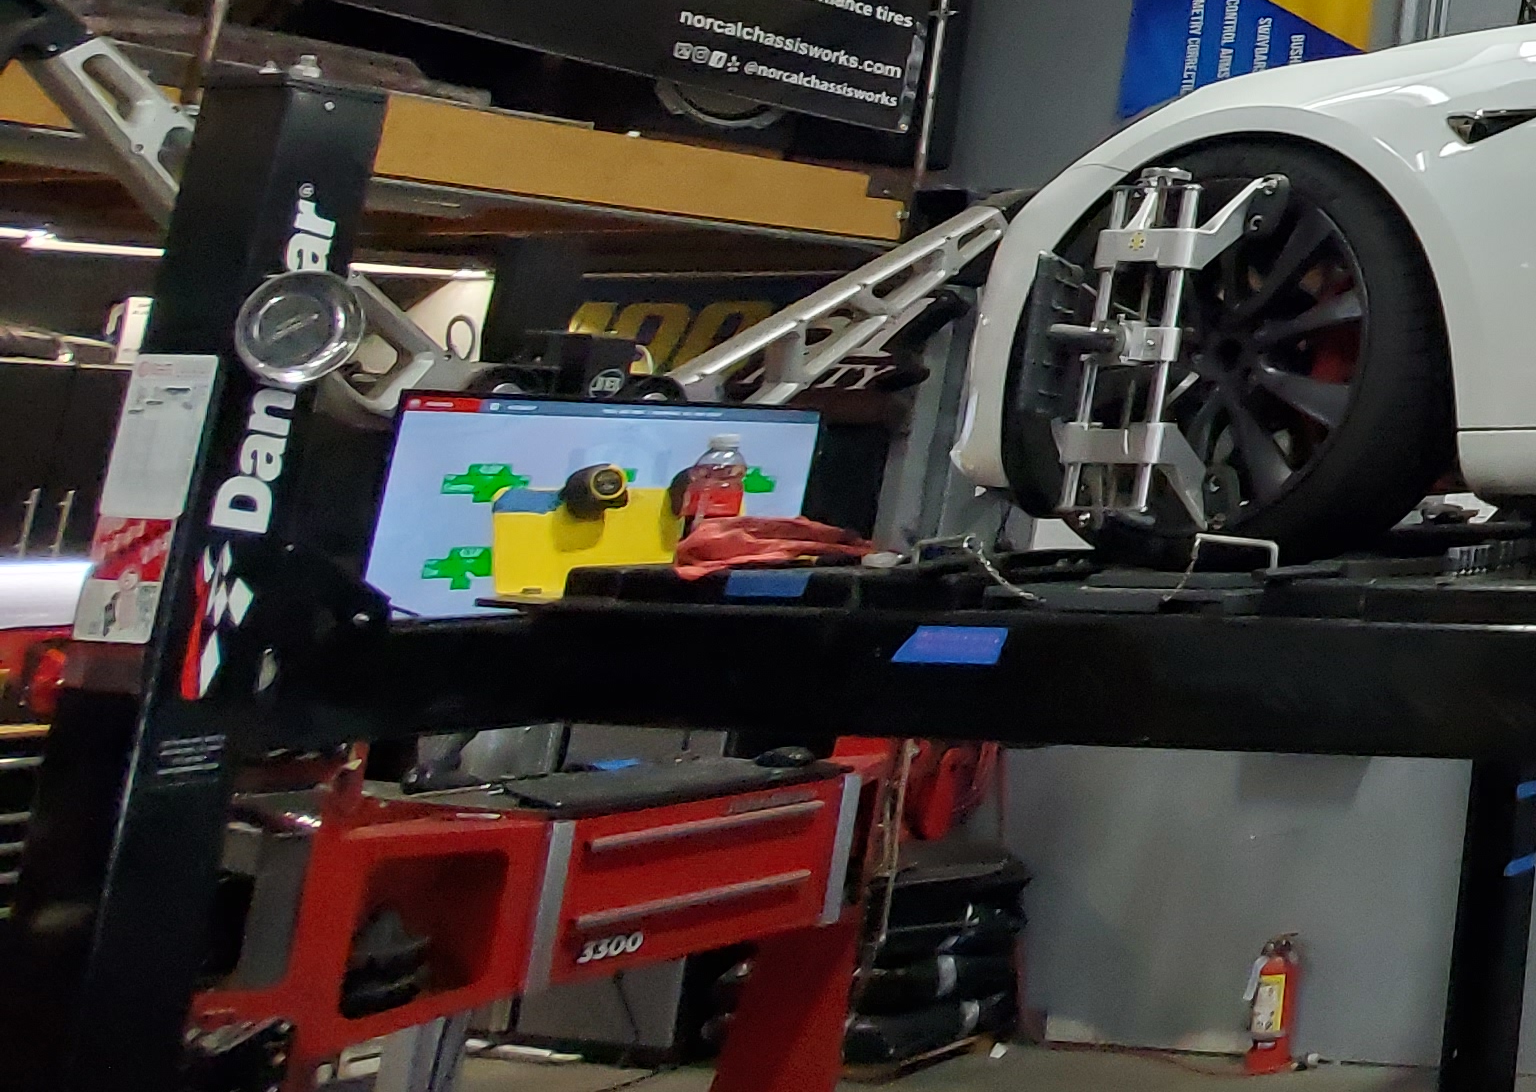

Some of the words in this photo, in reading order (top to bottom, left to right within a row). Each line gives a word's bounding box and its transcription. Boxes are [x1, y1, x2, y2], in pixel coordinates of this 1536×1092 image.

[875, 5, 914, 28] tires
[680, 9, 902, 79] norcalchassisworks.com
[1216, 49, 1234, 79] ARMS
[743, 60, 898, 108] @norcalchassisworks
